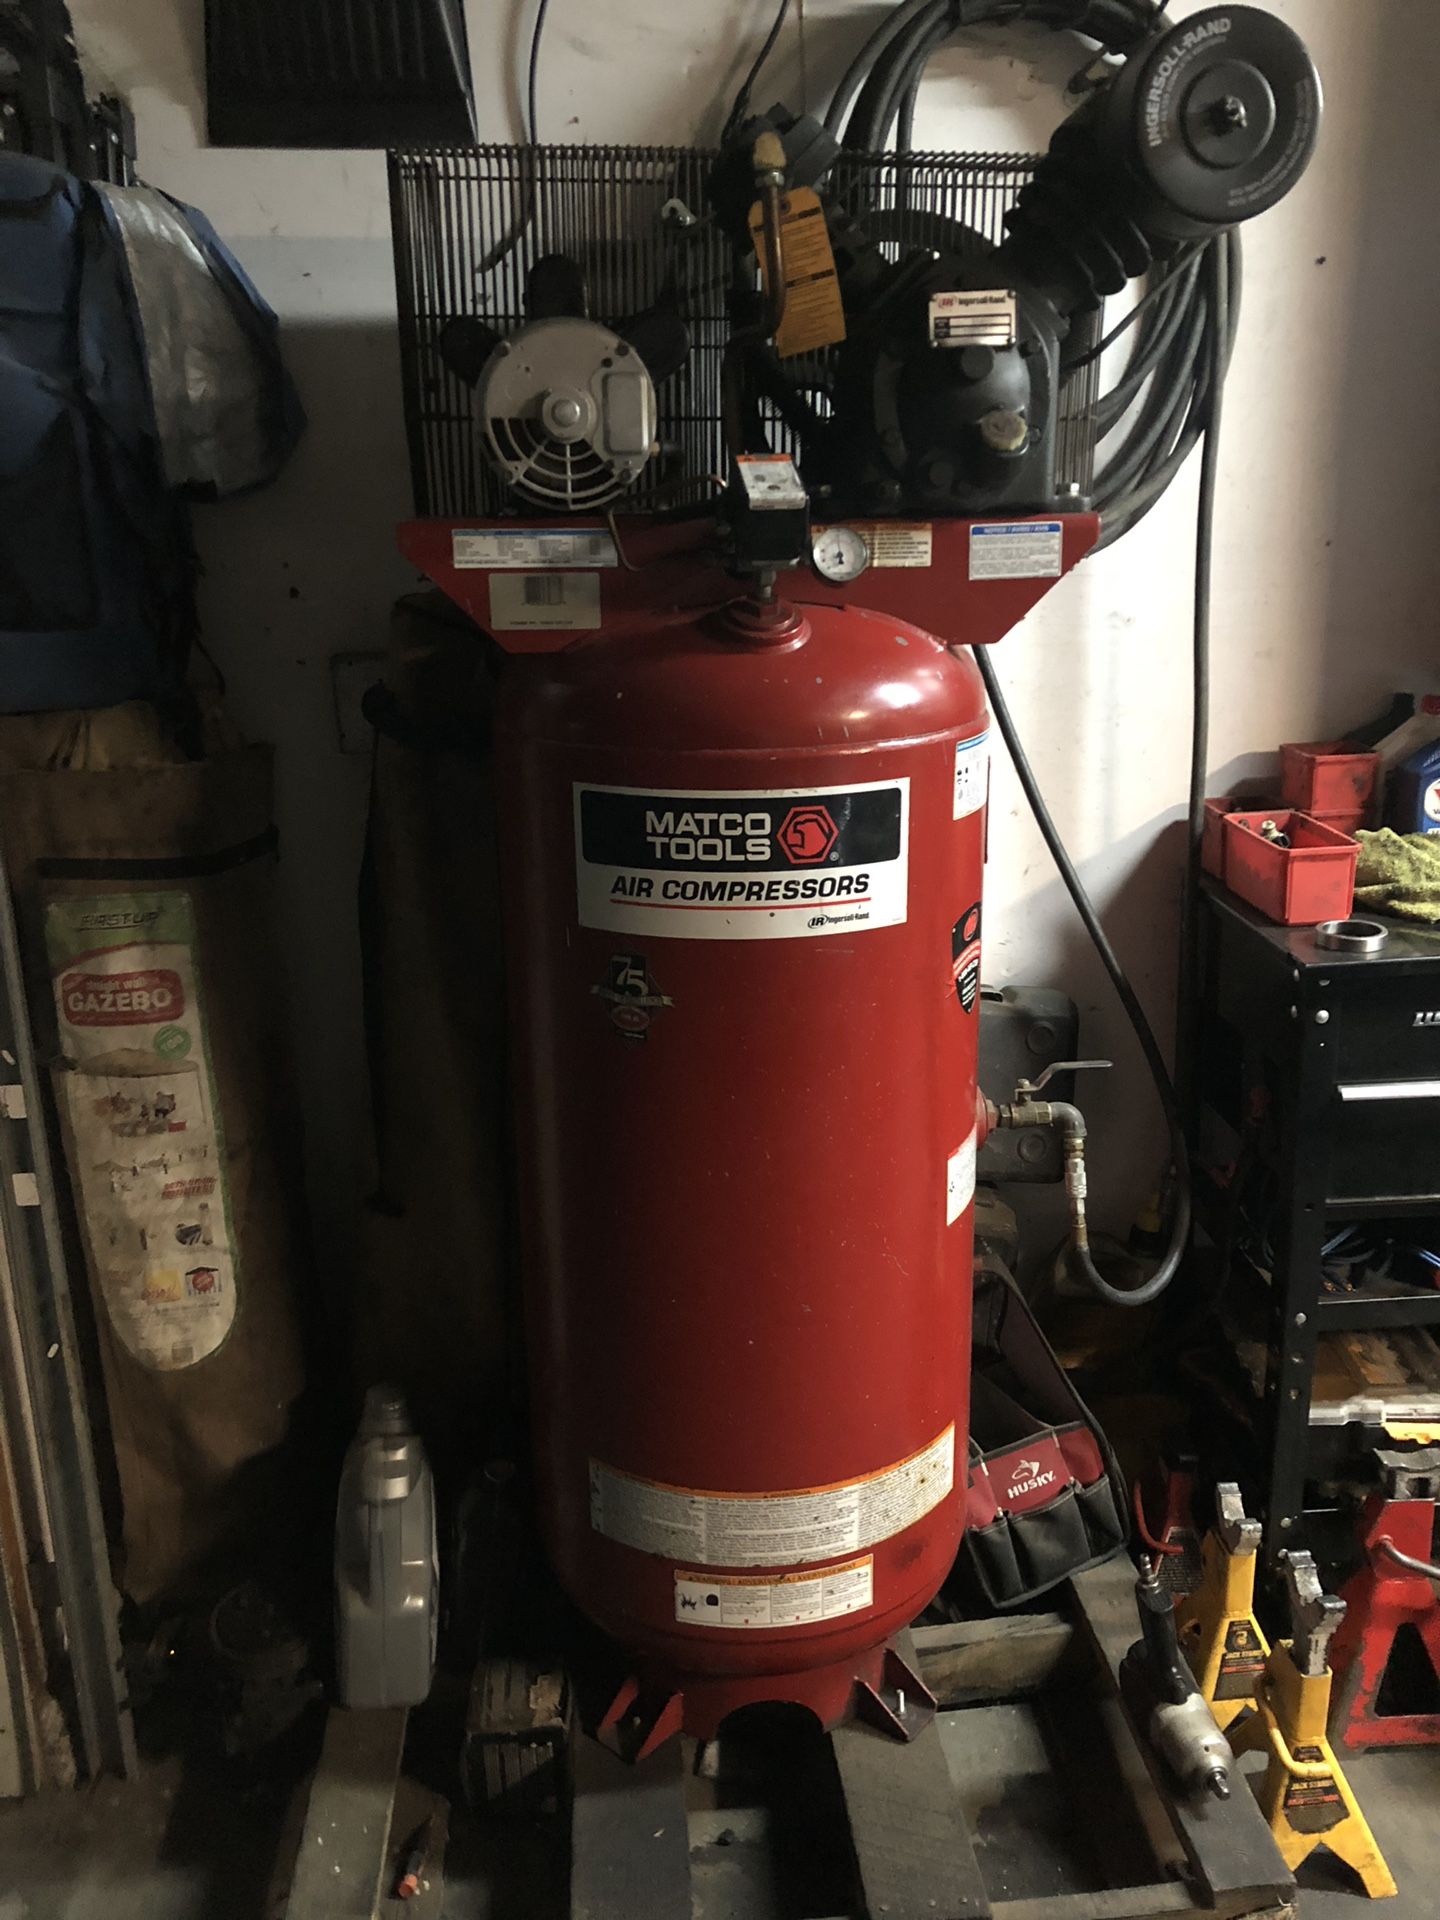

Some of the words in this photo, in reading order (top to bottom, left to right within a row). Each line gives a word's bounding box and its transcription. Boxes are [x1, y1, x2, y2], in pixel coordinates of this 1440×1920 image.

[1146, 18, 1232, 146] INGERSOLL-RAND
[645, 810, 771, 836] MATCO
[645, 836, 771, 862] TOOLS
[611, 875, 654, 898] AIR
[662, 873, 870, 901] COMPRESSORS
[809, 915, 826, 928] IR
[611, 954, 650, 996] 75
[68, 988, 172, 1013] GAZEBO
[1007, 1470, 1054, 1499] HUSKY
